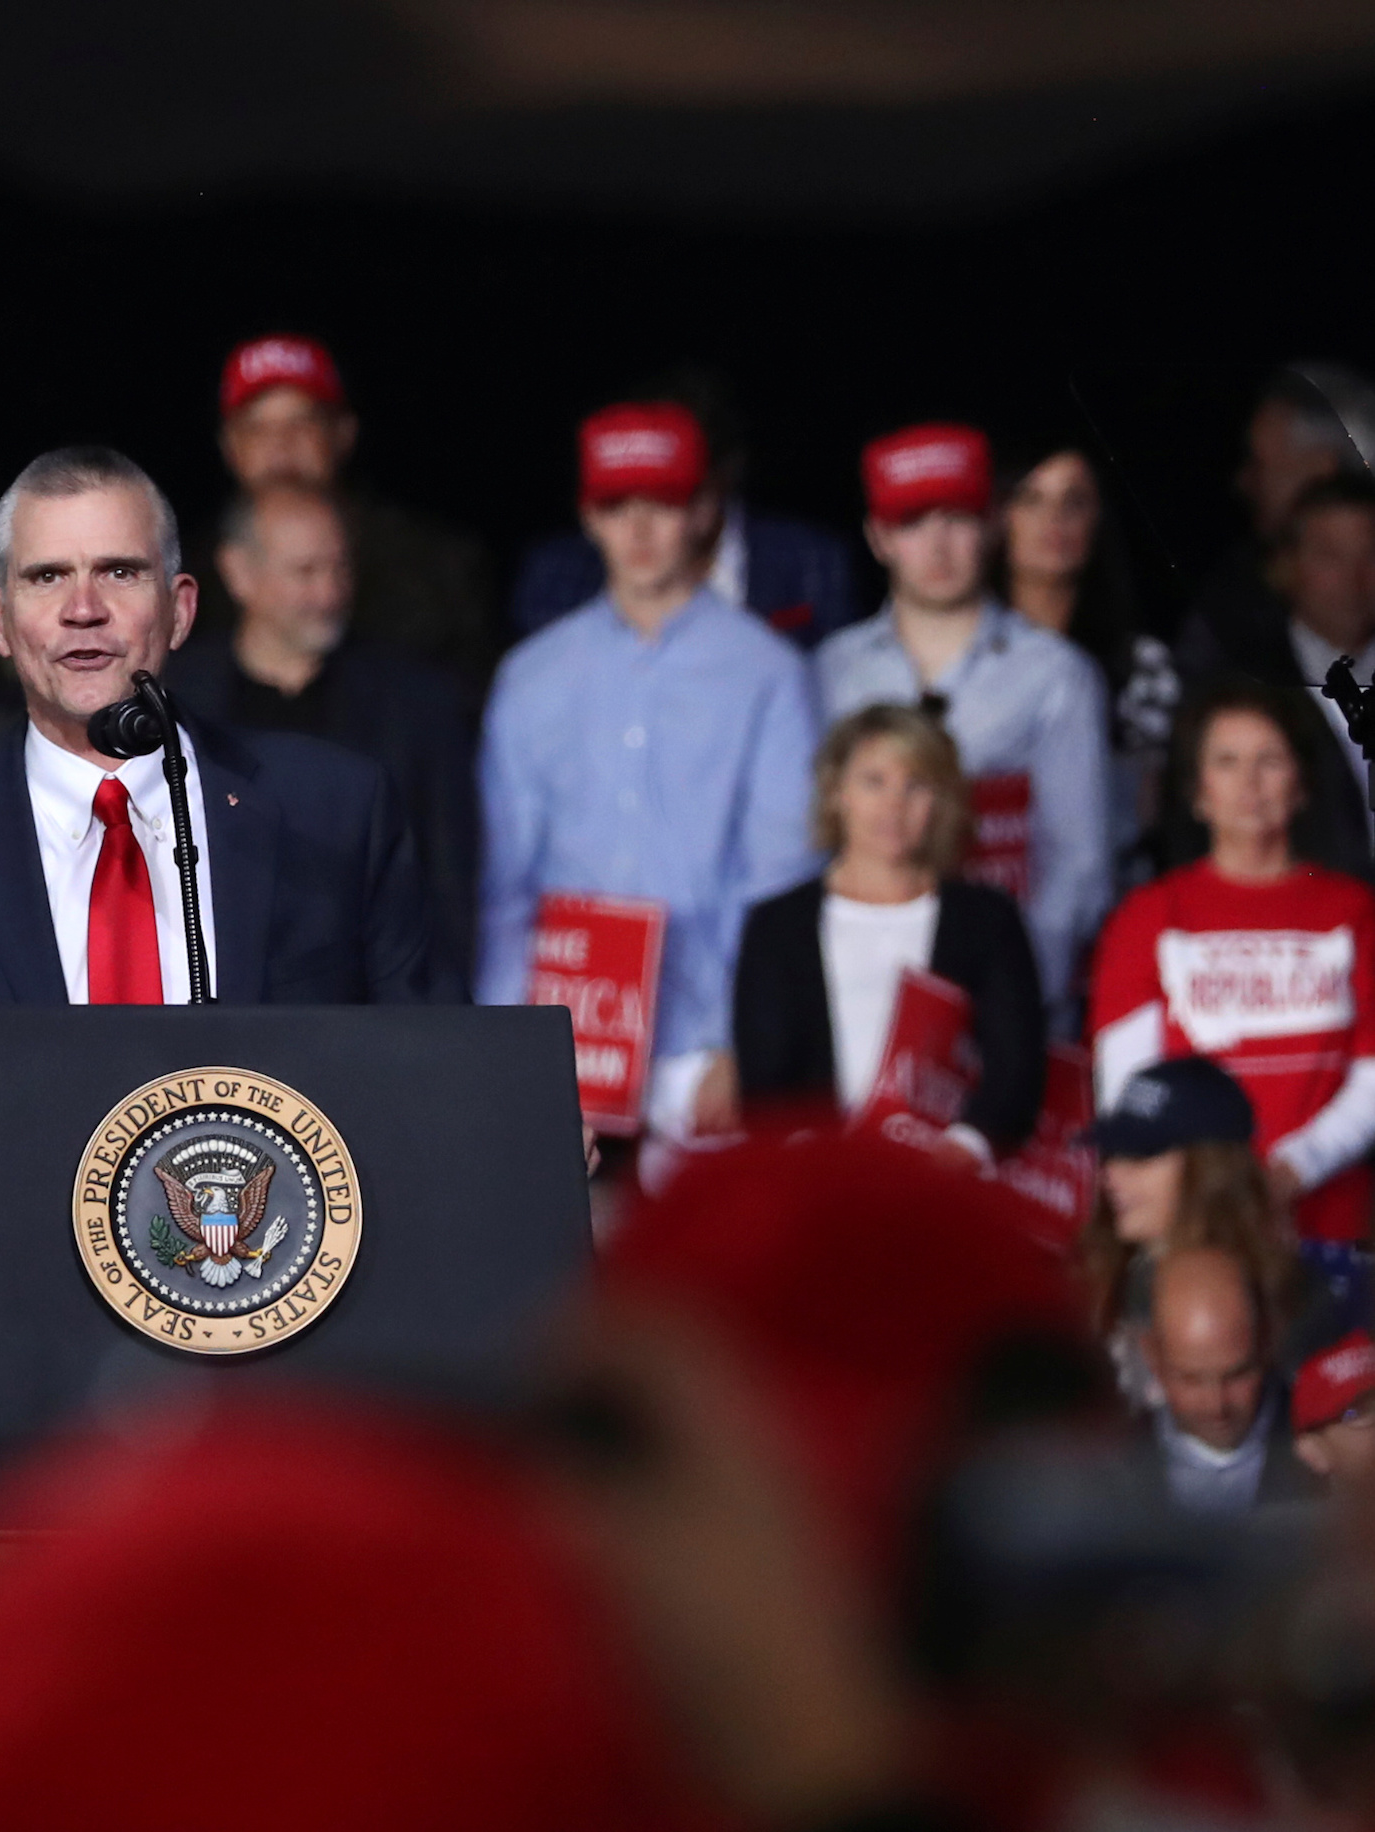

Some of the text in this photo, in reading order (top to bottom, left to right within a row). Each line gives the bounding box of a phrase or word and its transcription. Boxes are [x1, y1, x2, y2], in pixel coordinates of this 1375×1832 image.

[83, 1079, 352, 1340] SEAL OF THE PRESIDENT OF THE UNITED STATES
